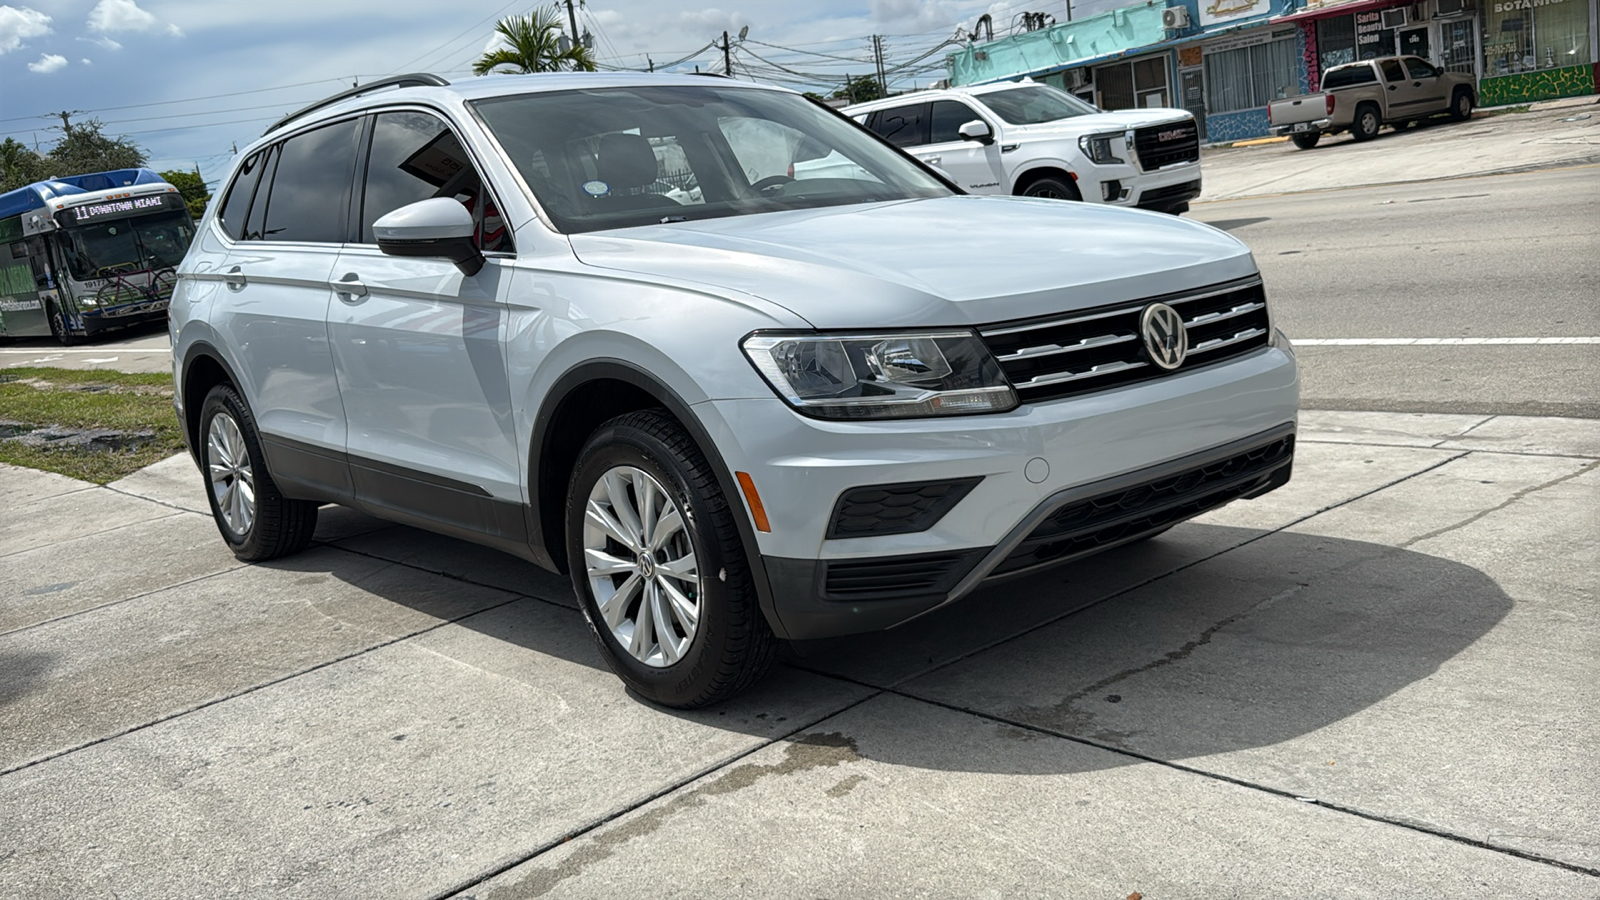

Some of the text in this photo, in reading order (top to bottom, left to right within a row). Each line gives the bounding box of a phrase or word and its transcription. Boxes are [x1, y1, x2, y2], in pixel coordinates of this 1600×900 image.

[1494, 0, 1567, 13] BOTANI
[1357, 12, 1379, 23] Sarita
[1358, 22, 1382, 34] Beauty
[1358, 33, 1380, 45] Salon
[1158, 129, 1187, 142] GMC
[75, 196, 162, 220] 11 DOWNTOWN MIAMI
